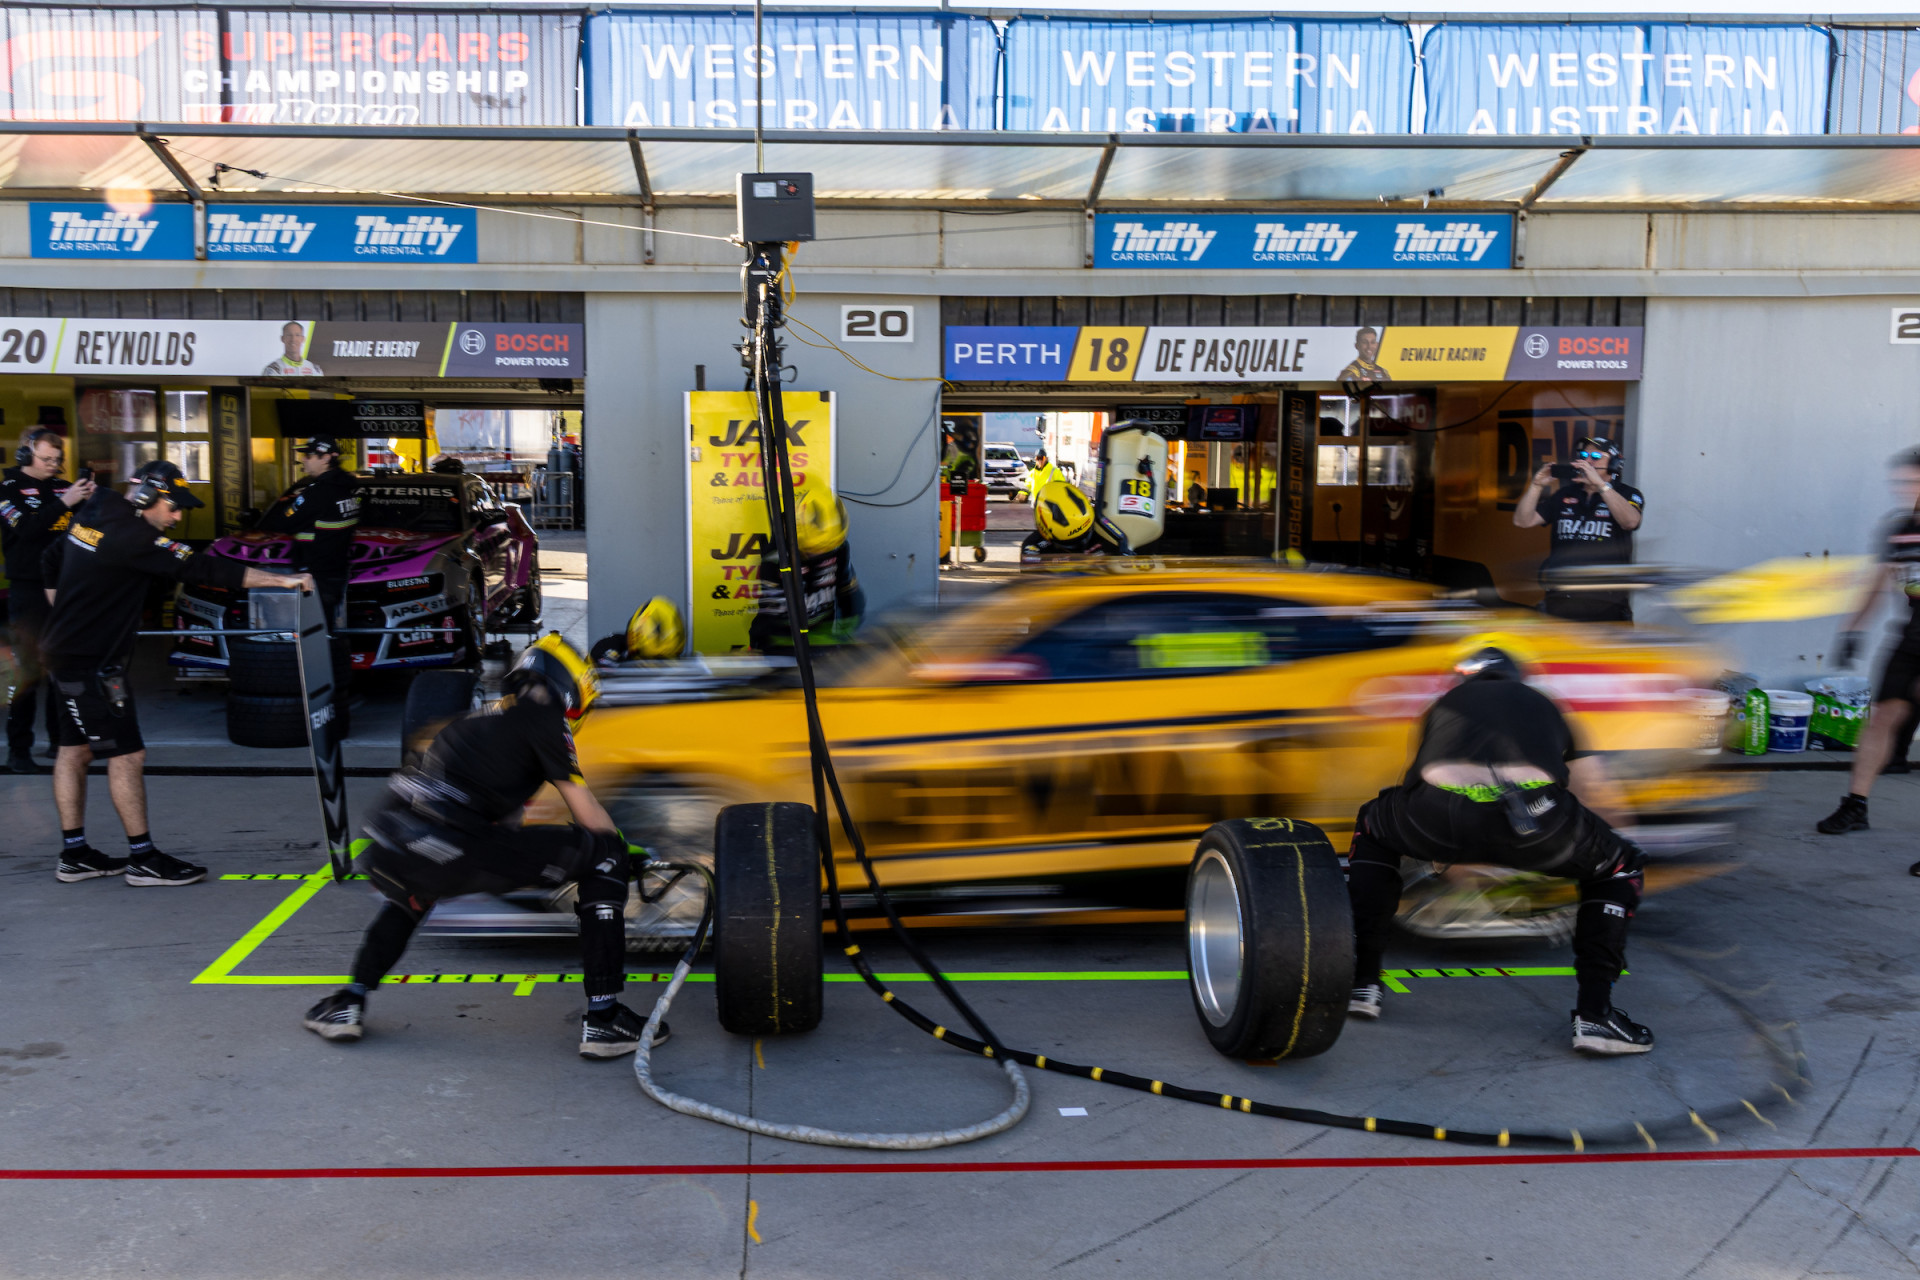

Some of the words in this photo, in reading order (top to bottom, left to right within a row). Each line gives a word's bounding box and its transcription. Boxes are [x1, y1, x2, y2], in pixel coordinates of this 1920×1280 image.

[183, 31, 530, 62] SUPERCARS
[642, 44, 943, 79] WESTERN
[1062, 51, 1360, 89] WESTERN
[1488, 53, 1776, 90] WESTERN
[183, 70, 530, 94] CHAMPIONSHIP
[49, 211, 160, 252] Thrifty
[208, 213, 317, 254] Thrifty
[354, 215, 463, 255] Thrifty
[49, 242, 73, 252] CAR
[75, 242, 120, 252] RENTAL
[208, 244, 231, 253] CAR
[233, 244, 278, 254] RENTAL
[354, 245, 377, 255] CAR
[379, 246, 424, 255] RENTAL
[1111, 223, 1217, 261] Thrifty
[1252, 223, 1358, 261] Thrifty
[1393, 223, 1498, 261] Thrifty
[1111, 252, 1134, 261] CAR
[1137, 252, 1178, 261] RENTAL
[1253, 252, 1276, 261] CAR
[1278, 252, 1319, 261] RENTAL
[1393, 252, 1416, 261] CAR
[1418, 252, 1460, 261] RENTAL
[846, 310, 908, 337] 20
[1897, 313, 1920, 338] 2
[1, 329, 47, 364] 20
[74, 330, 197, 366] REYNOLDS
[333, 340, 373, 357] TRADIE
[376, 340, 420, 358] ENERGY
[495, 334, 569, 352] BOSCH
[1558, 337, 1629, 355] BOSCH
[495, 356, 534, 366] POWER
[536, 357, 569, 366] TOOLS
[953, 343, 1061, 365] PERTH
[1089, 338, 1128, 372] 18
[1155, 339, 1185, 372] DE
[1190, 338, 1308, 378] PASQUALE
[1400, 348, 1445, 361] DEWALT
[1446, 348, 1487, 361] RACING
[1557, 360, 1594, 369] POWER
[1596, 360, 1628, 369] TOOLS
[358, 404, 417, 416] 09:19:38
[1123, 409, 1181, 420] 09:19:29
[361, 421, 419, 432] 00:10:22
[220, 394, 241, 525] REYNOLDS
[720, 452, 809, 468] TYS
[710, 472, 728, 487] &
[733, 471, 806, 487] AUO
[1127, 480, 1151, 497] 18
[352, 486, 455, 498] ATTERIES
[1557, 518, 1613, 538] TRADIE
[710, 533, 770, 560] JA
[711, 585, 729, 599] &
